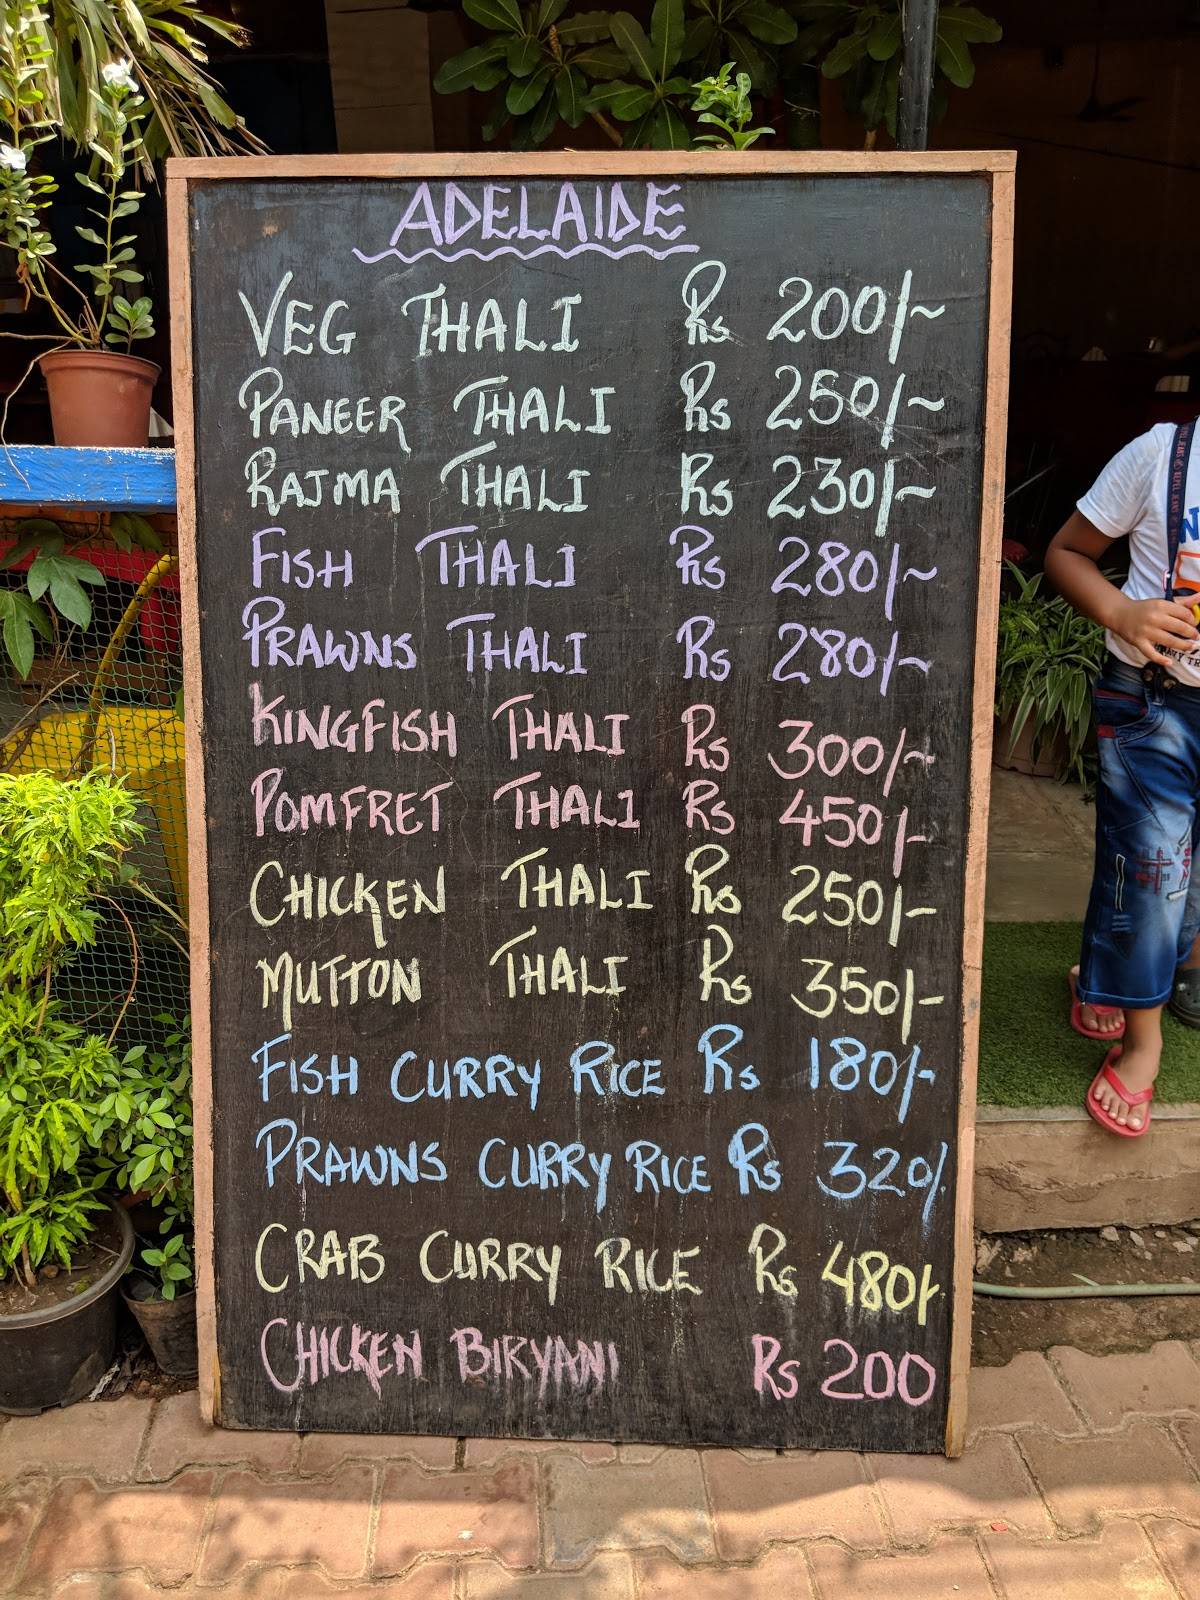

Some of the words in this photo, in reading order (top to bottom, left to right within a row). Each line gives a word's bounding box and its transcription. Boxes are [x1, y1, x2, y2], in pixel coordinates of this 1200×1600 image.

[390, 182, 686, 246] ADELAIDE
[239, 271, 356, 357] VEG
[401, 283, 582, 354] THALI
[682, 260, 730, 345] Rs
[239, 366, 411, 453] PANEER
[454, 375, 616, 435] THALI
[680, 361, 731, 433] Rs
[245, 447, 400, 516] RAJMA
[440, 441, 591, 512] THALI
[680, 452, 733, 516] Rs
[252, 527, 353, 588] FISH
[415, 525, 577, 587] THALI
[669, 525, 726, 589] Rs
[242, 596, 418, 672] PRAWNS
[446, 613, 588, 674] THALI
[676, 616, 731, 681] Rs
[249, 680, 457, 757] KINGFISH
[492, 694, 631, 760] THALI
[681, 704, 730, 771] Rs
[250, 768, 453, 837] POMFRET
[493, 772, 641, 829] THALI
[682, 780, 735, 835] Rs
[250, 861, 445, 949] CHICKEN
[501, 847, 654, 910] THALI
[685, 843, 741, 914] Rs
[255, 951, 422, 1031] MUTTON
[489, 925, 628, 998] THALI
[700, 925, 752, 1004] Rs
[252, 1033, 359, 1101] FISH
[391, 1050, 541, 1111] CURRY
[570, 1040, 666, 1097] RICE
[699, 1024, 760, 1094] Rs
[255, 1118, 448, 1188] PRAWNS
[478, 1137, 612, 1215] CURRY
[625, 1140, 711, 1193] RICE
[728, 1123, 782, 1195] Rs
[255, 1223, 385, 1294] CRAB
[420, 1230, 561, 1306] CURRY
[594, 1237, 701, 1295] RICE
[748, 1223, 798, 1295] Rs
[261, 1317, 423, 1399] CHICKEN
[450, 1326, 620, 1398] BIRYANI
[751, 1334, 799, 1400] Rs
[821, 1338, 936, 1406] 200
